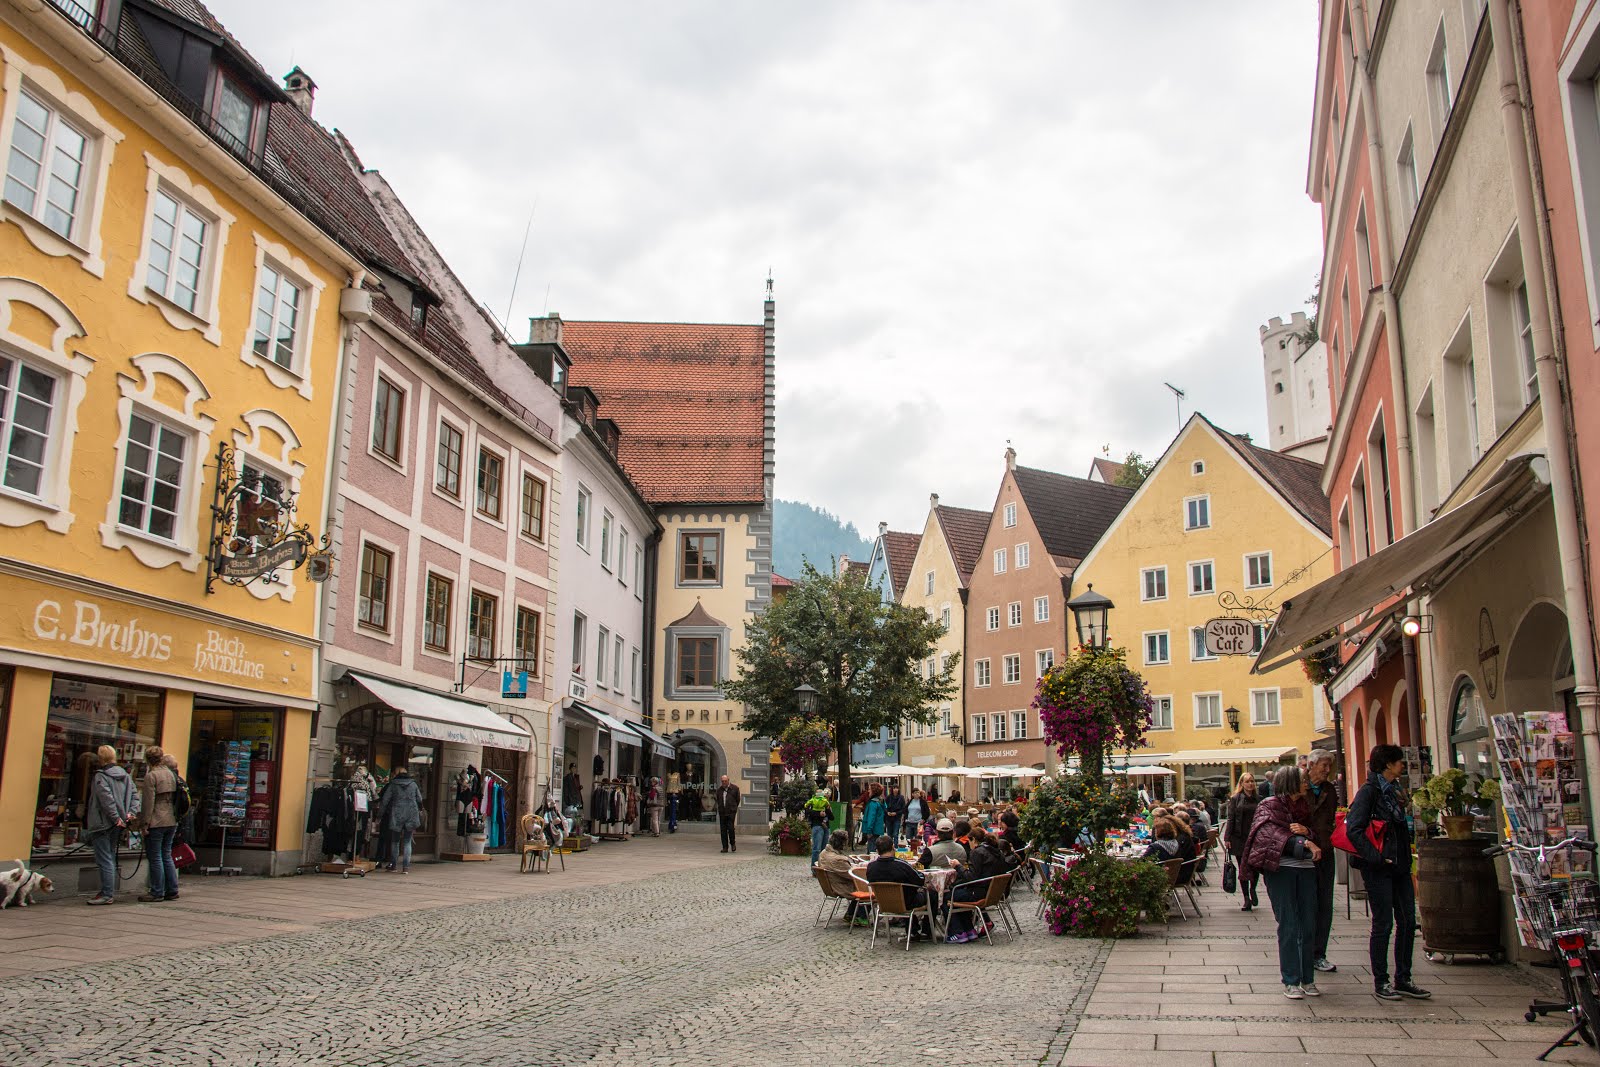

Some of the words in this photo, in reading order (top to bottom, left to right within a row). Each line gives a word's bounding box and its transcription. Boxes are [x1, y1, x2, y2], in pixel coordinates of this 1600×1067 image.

[1209, 621, 1249, 637] Stadt
[205, 629, 248, 658] Buch-
[1216, 636, 1244, 652] Cafe
[656, 708, 734, 722] ESPRIT
[976, 750, 1002, 758] TELECOM
[1002, 749, 1019, 757] SHOP
